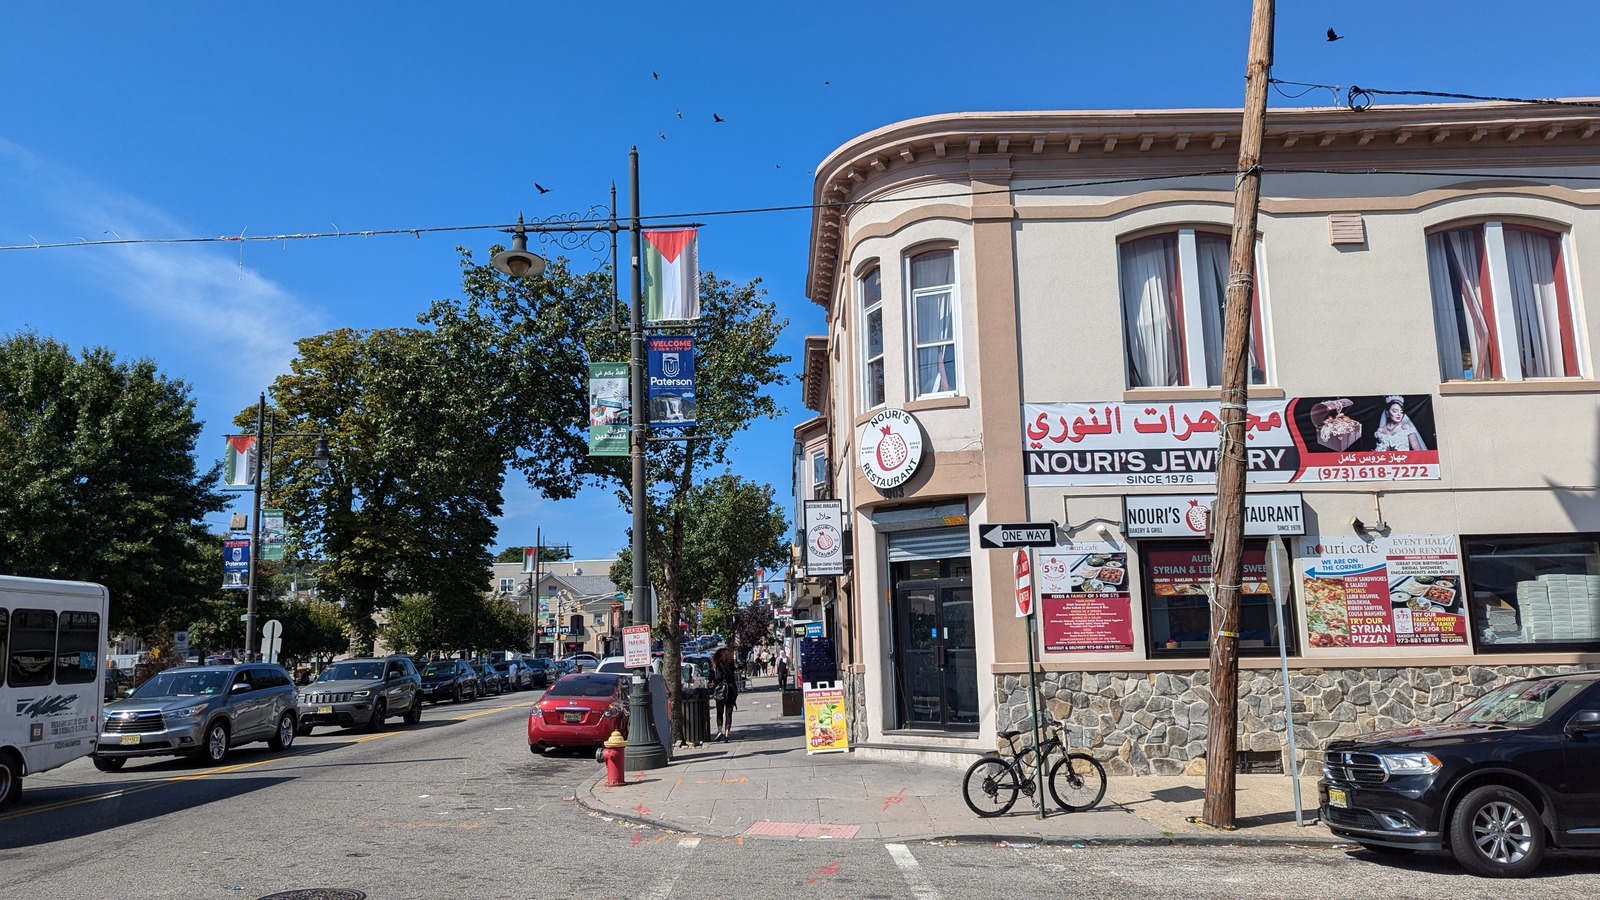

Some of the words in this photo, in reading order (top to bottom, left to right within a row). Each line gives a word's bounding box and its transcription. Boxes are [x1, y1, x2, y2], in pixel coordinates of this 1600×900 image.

[650, 377, 692, 385] Paterson
[871, 411, 910, 428] NOURI'S
[1134, 405, 1281, 440] مجهرات
[1027, 405, 1121, 449] النوري
[1030, 451, 1147, 473] NOURI'S
[1152, 449, 1286, 471] JEWRY
[1338, 454, 1356, 464] كامل
[1360, 454, 1386, 464] عروس
[1389, 453, 1408, 463] جهاز
[863, 458, 917, 487] RESTAURANT
[1318, 467, 1355, 480] (973)
[1359, 466, 1428, 479] 618-7272
[1126, 475, 1162, 484] SINCE
[1165, 474, 1194, 483] 1976
[816, 512, 831, 520] حلال
[1128, 506, 1180, 524] NOURI'S
[1245, 506, 1300, 522] TAURANT
[1002, 531, 1022, 541] ONE
[1026, 530, 1047, 540] WAY
[1393, 538, 1421, 546] EVENT
[810, 545, 838, 556] RESTAURANT
[1420, 546, 1455, 554] RENTAL
[1153, 566, 1186, 574] SYRIAN
[1189, 566, 1196, 574] &
[1243, 564, 1267, 573] SWEE
[1020, 590, 1029, 603] ENTER
[624, 627, 648, 635] EMERGENCY
[1351, 624, 1391, 634] SYRIAN
[1352, 634, 1388, 643] PIZZA!
